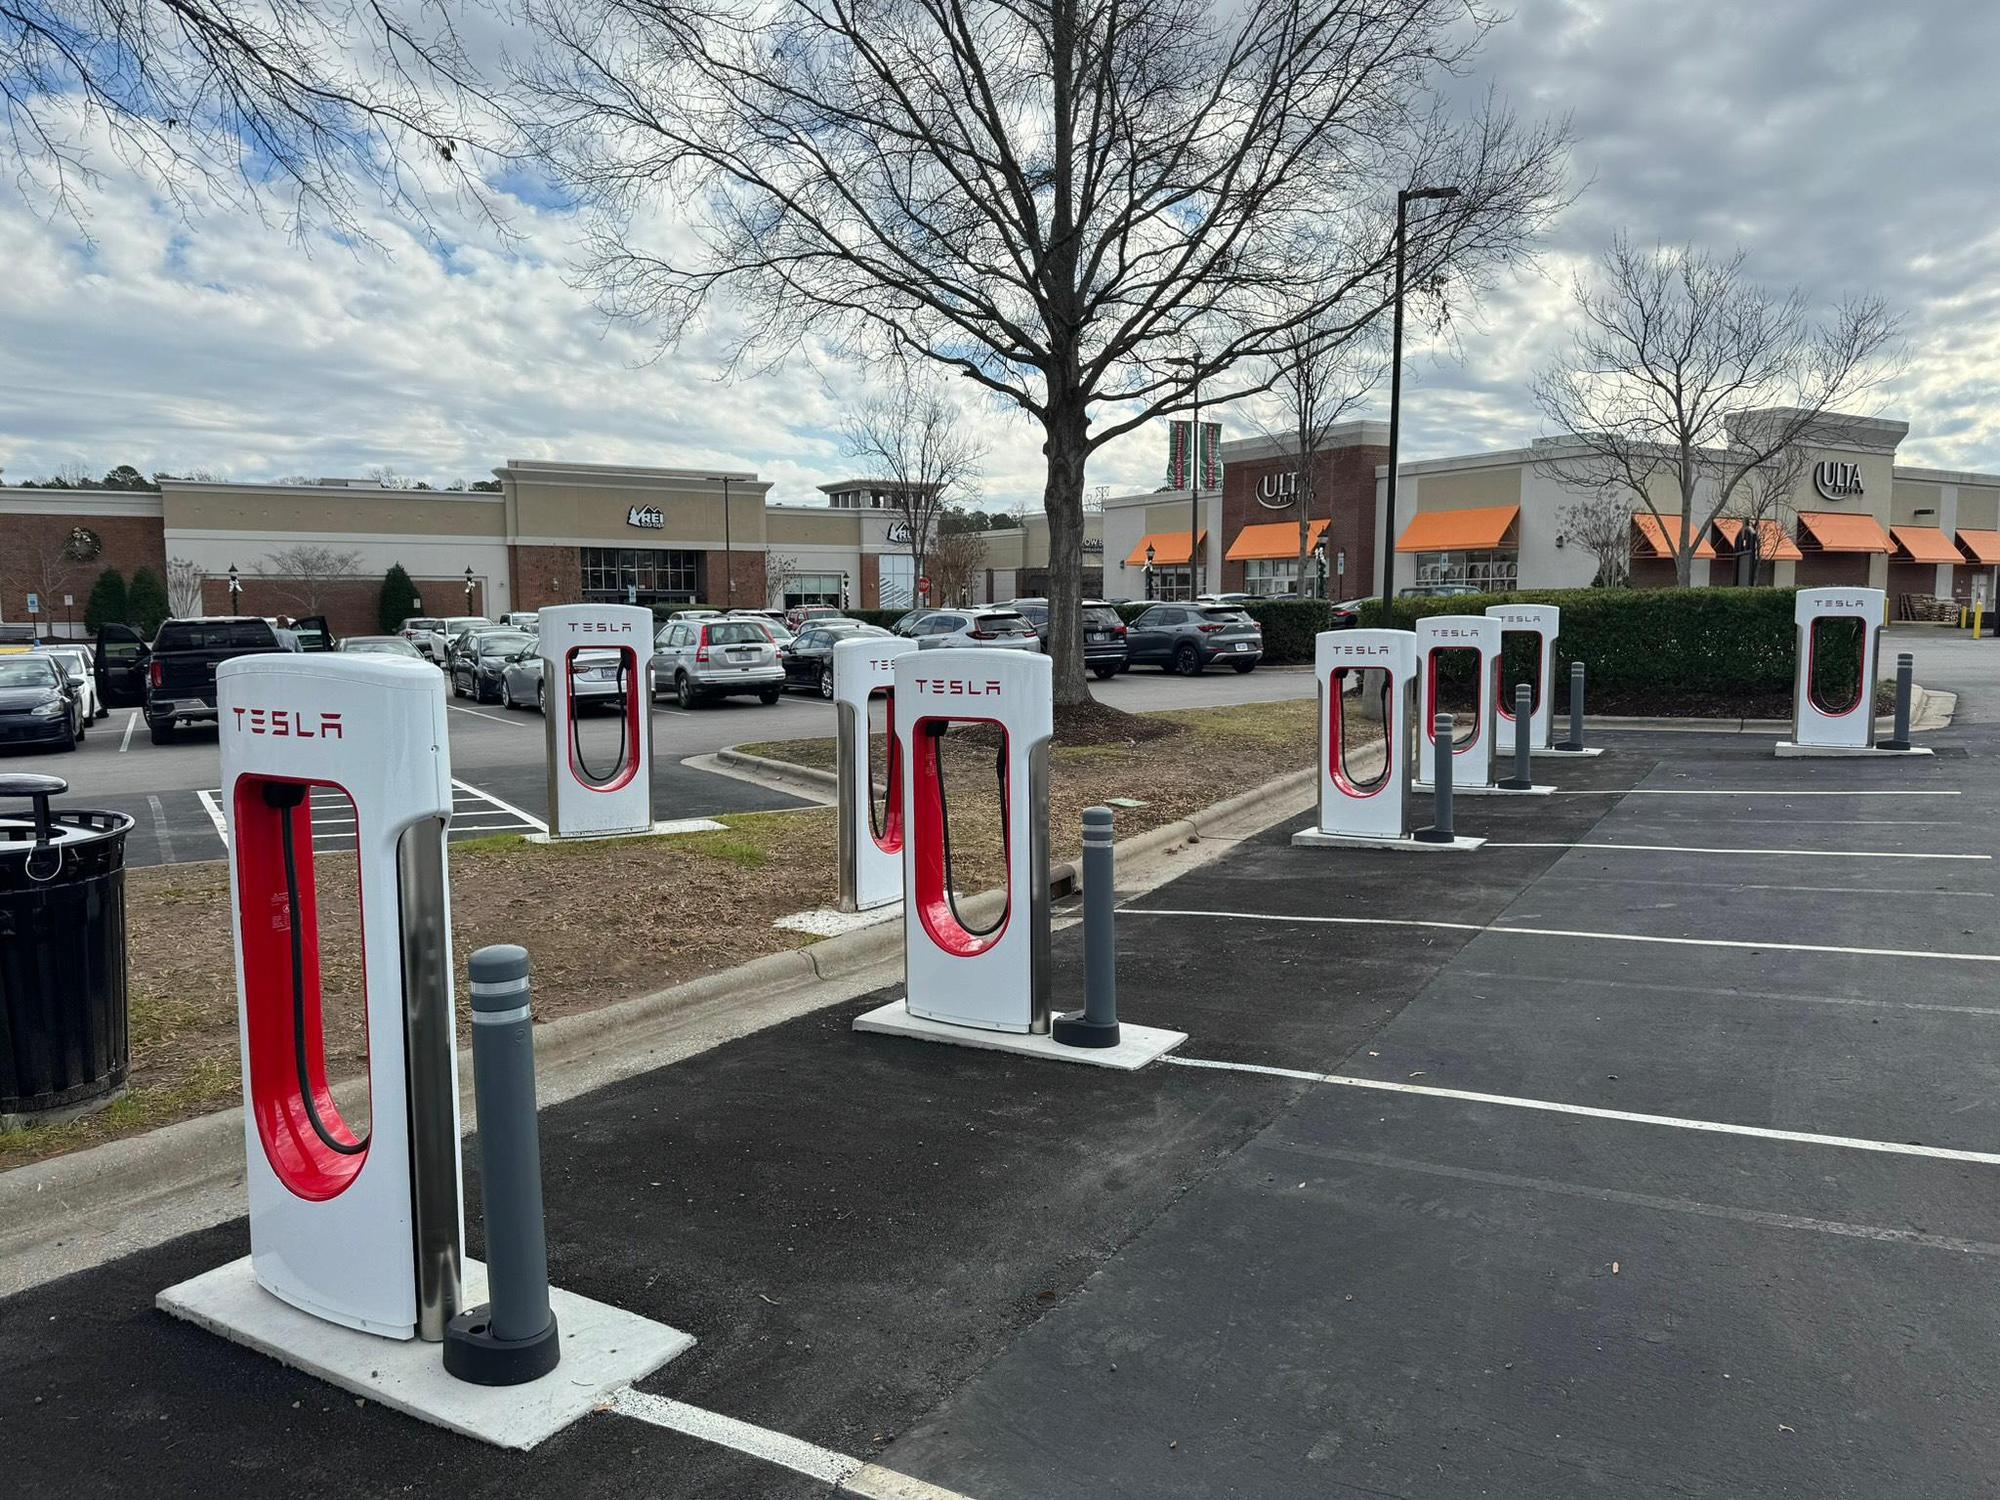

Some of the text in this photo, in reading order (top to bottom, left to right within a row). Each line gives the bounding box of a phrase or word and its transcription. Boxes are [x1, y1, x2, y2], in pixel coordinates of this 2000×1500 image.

[1823, 462, 1864, 489] ULTA
[1264, 472, 1298, 498] ULT
[642, 513, 664, 524] REI
[1814, 599, 1865, 608] TESLA
[1500, 615, 1541, 623] TESLA
[568, 622, 632, 632] TESLA
[1431, 629, 1479, 637] TESLA
[1333, 645, 1389, 655] TESLA
[915, 679, 1001, 696] TESLA
[233, 707, 343, 740] TESLA
